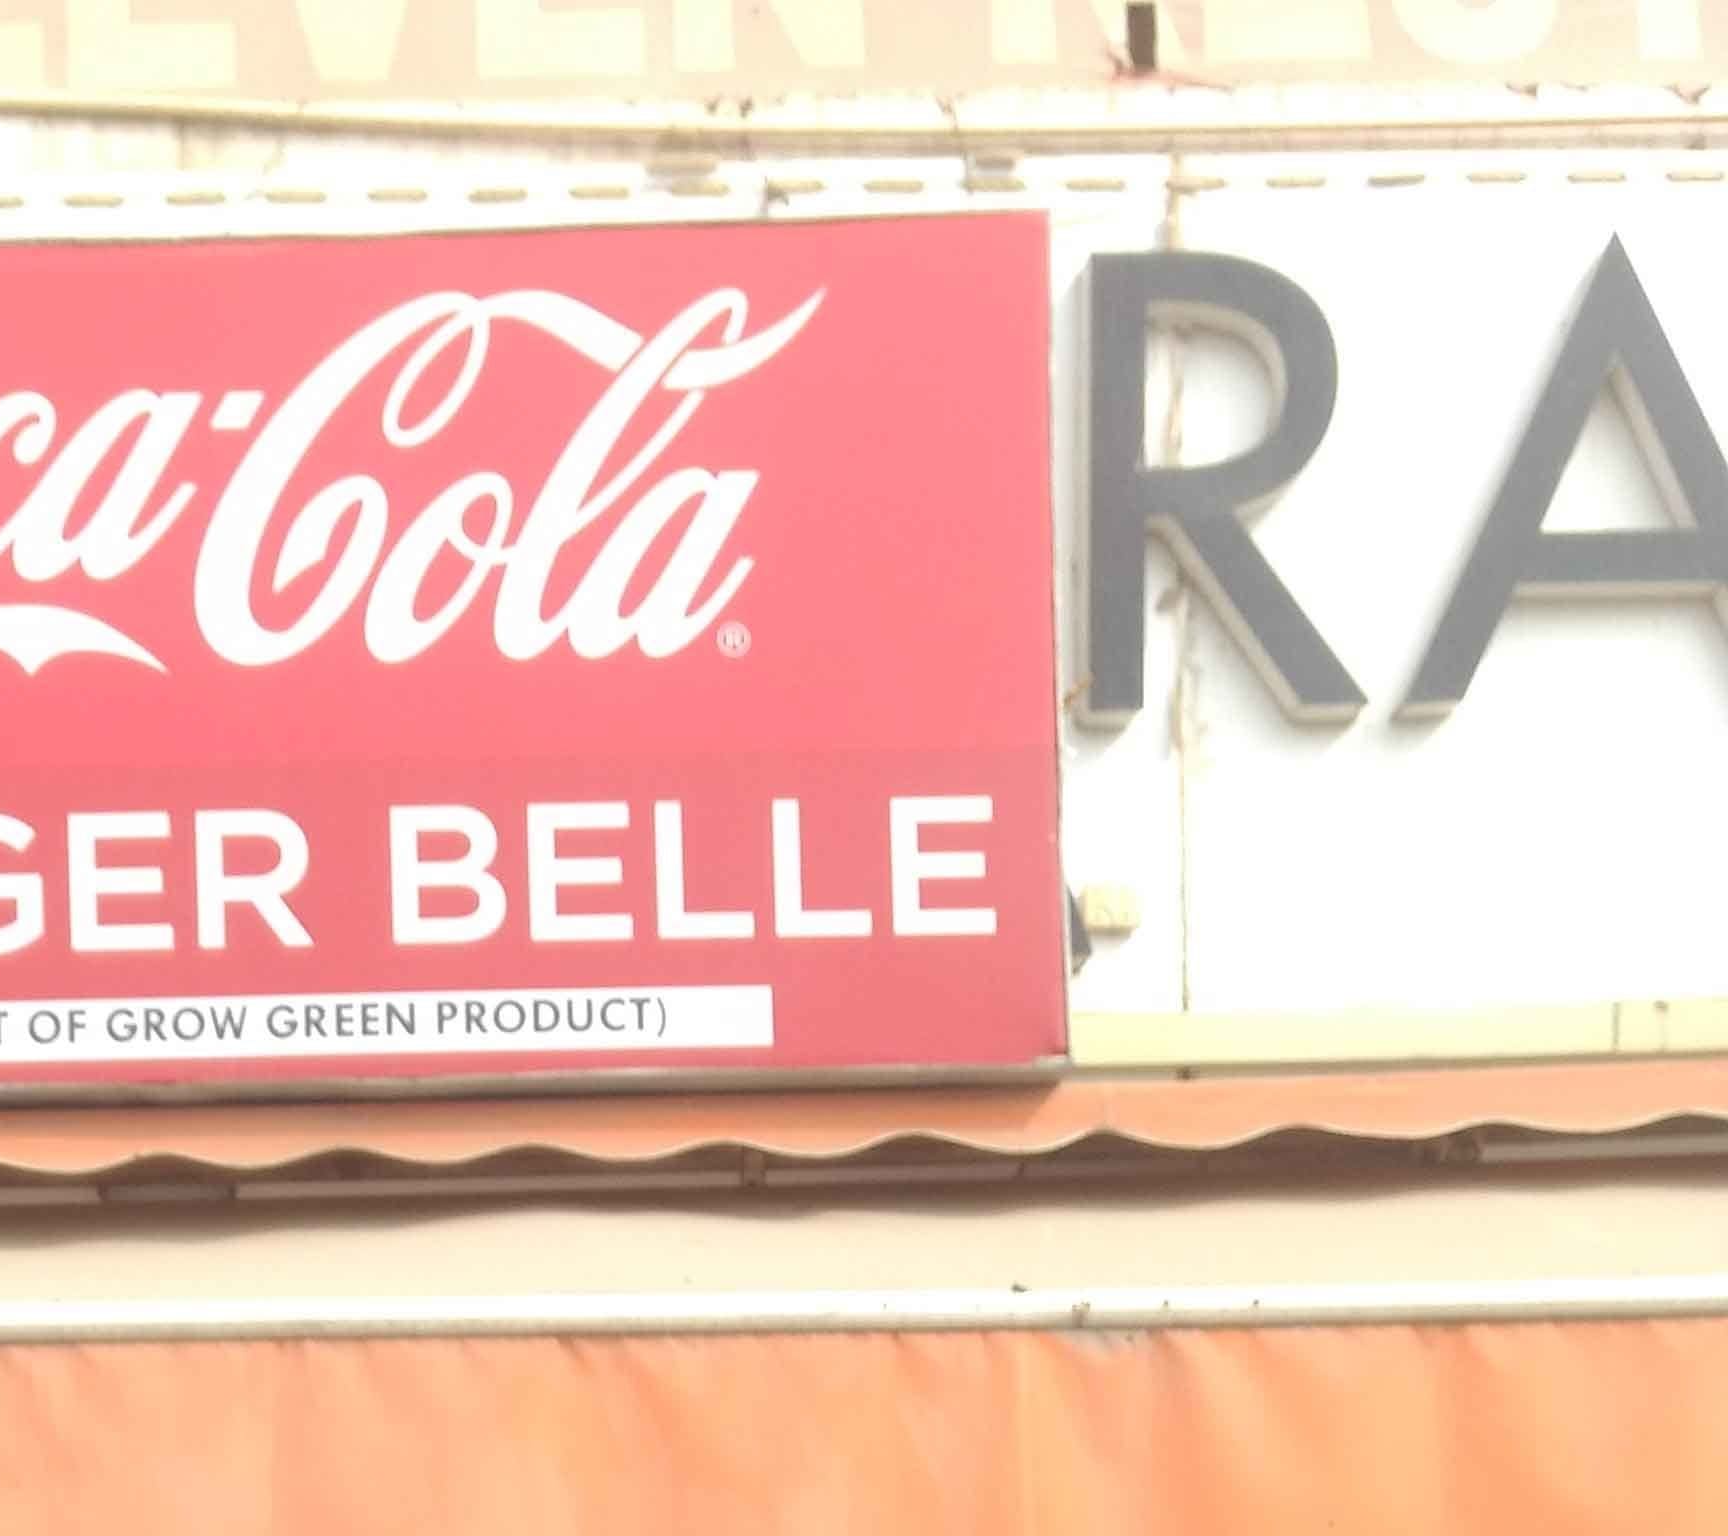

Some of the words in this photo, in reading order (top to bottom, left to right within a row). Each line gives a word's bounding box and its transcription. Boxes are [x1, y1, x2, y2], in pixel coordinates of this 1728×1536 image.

[388, 794, 999, 946] BELLE
[28, 1009, 87, 1045] OF
[105, 1005, 247, 1043] GROW
[266, 1002, 417, 1040] GREEN
[435, 996, 670, 1040] PRODUCT)
